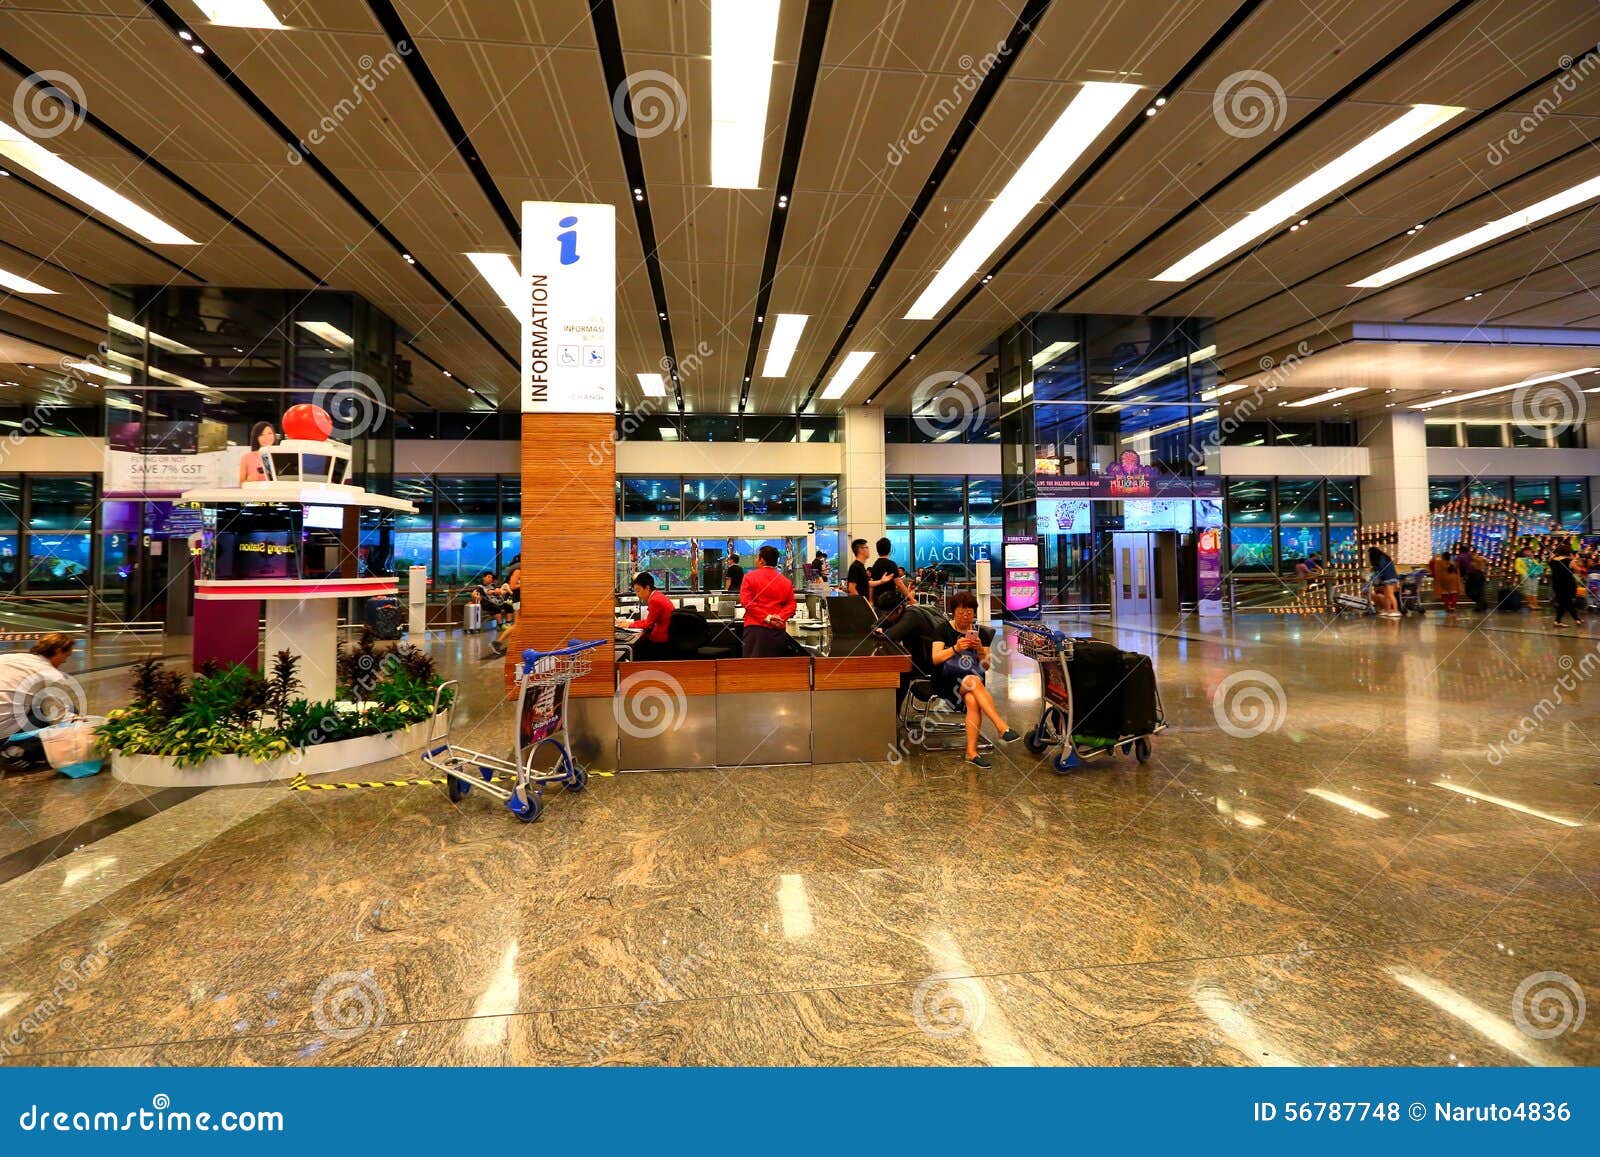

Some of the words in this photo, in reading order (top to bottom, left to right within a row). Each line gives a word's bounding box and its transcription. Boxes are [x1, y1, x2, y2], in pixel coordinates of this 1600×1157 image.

[564, 325, 604, 333] INFORMASI
[532, 275, 548, 401] INFORMATION
[131, 464, 158, 474] SAVE
[162, 464, 178, 474] 7%
[181, 464, 202, 474] GST
[807, 522, 815, 534] 3
[903, 546, 988, 560] IMAGINE
